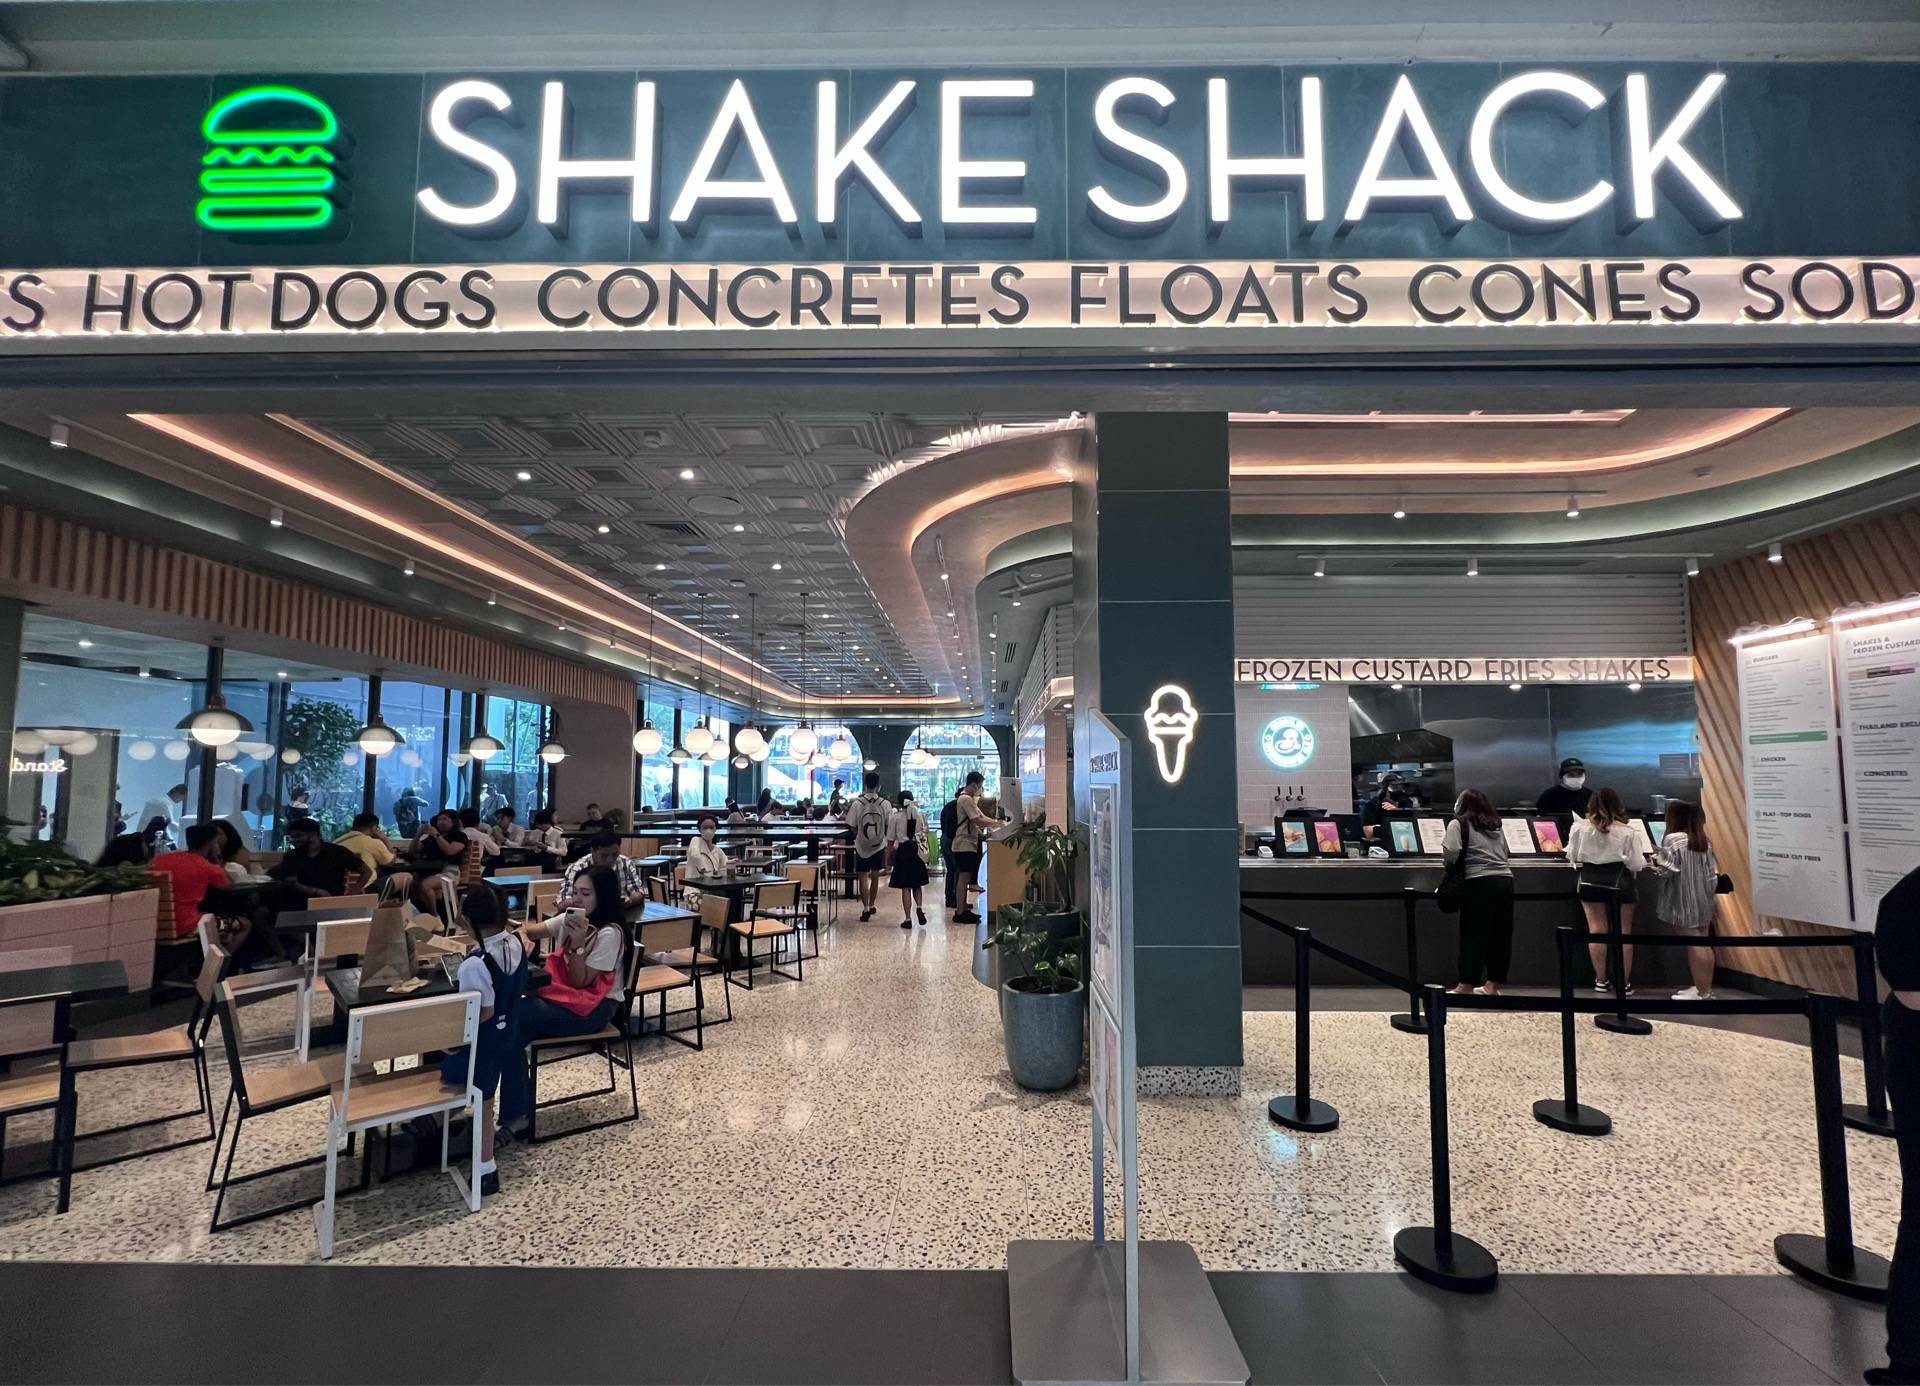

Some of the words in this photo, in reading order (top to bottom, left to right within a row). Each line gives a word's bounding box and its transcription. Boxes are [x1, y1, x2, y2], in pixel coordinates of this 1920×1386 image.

[417, 78, 1037, 226] SHAKE
[1087, 72, 1743, 222] SHACK
[0, 274, 44, 331] S
[83, 273, 251, 329] HOT
[271, 271, 496, 330] DOGS
[537, 264, 1030, 327] CONCRETES
[1070, 263, 1368, 324] FLOATS
[1409, 262, 1700, 323] CONES
[1742, 262, 1920, 320] SOD
[1237, 660, 1341, 681] FROZEN
[1352, 660, 1471, 681] CUSTARD
[1485, 660, 1555, 681] FRIES
[1568, 659, 1671, 681] SHAKES
